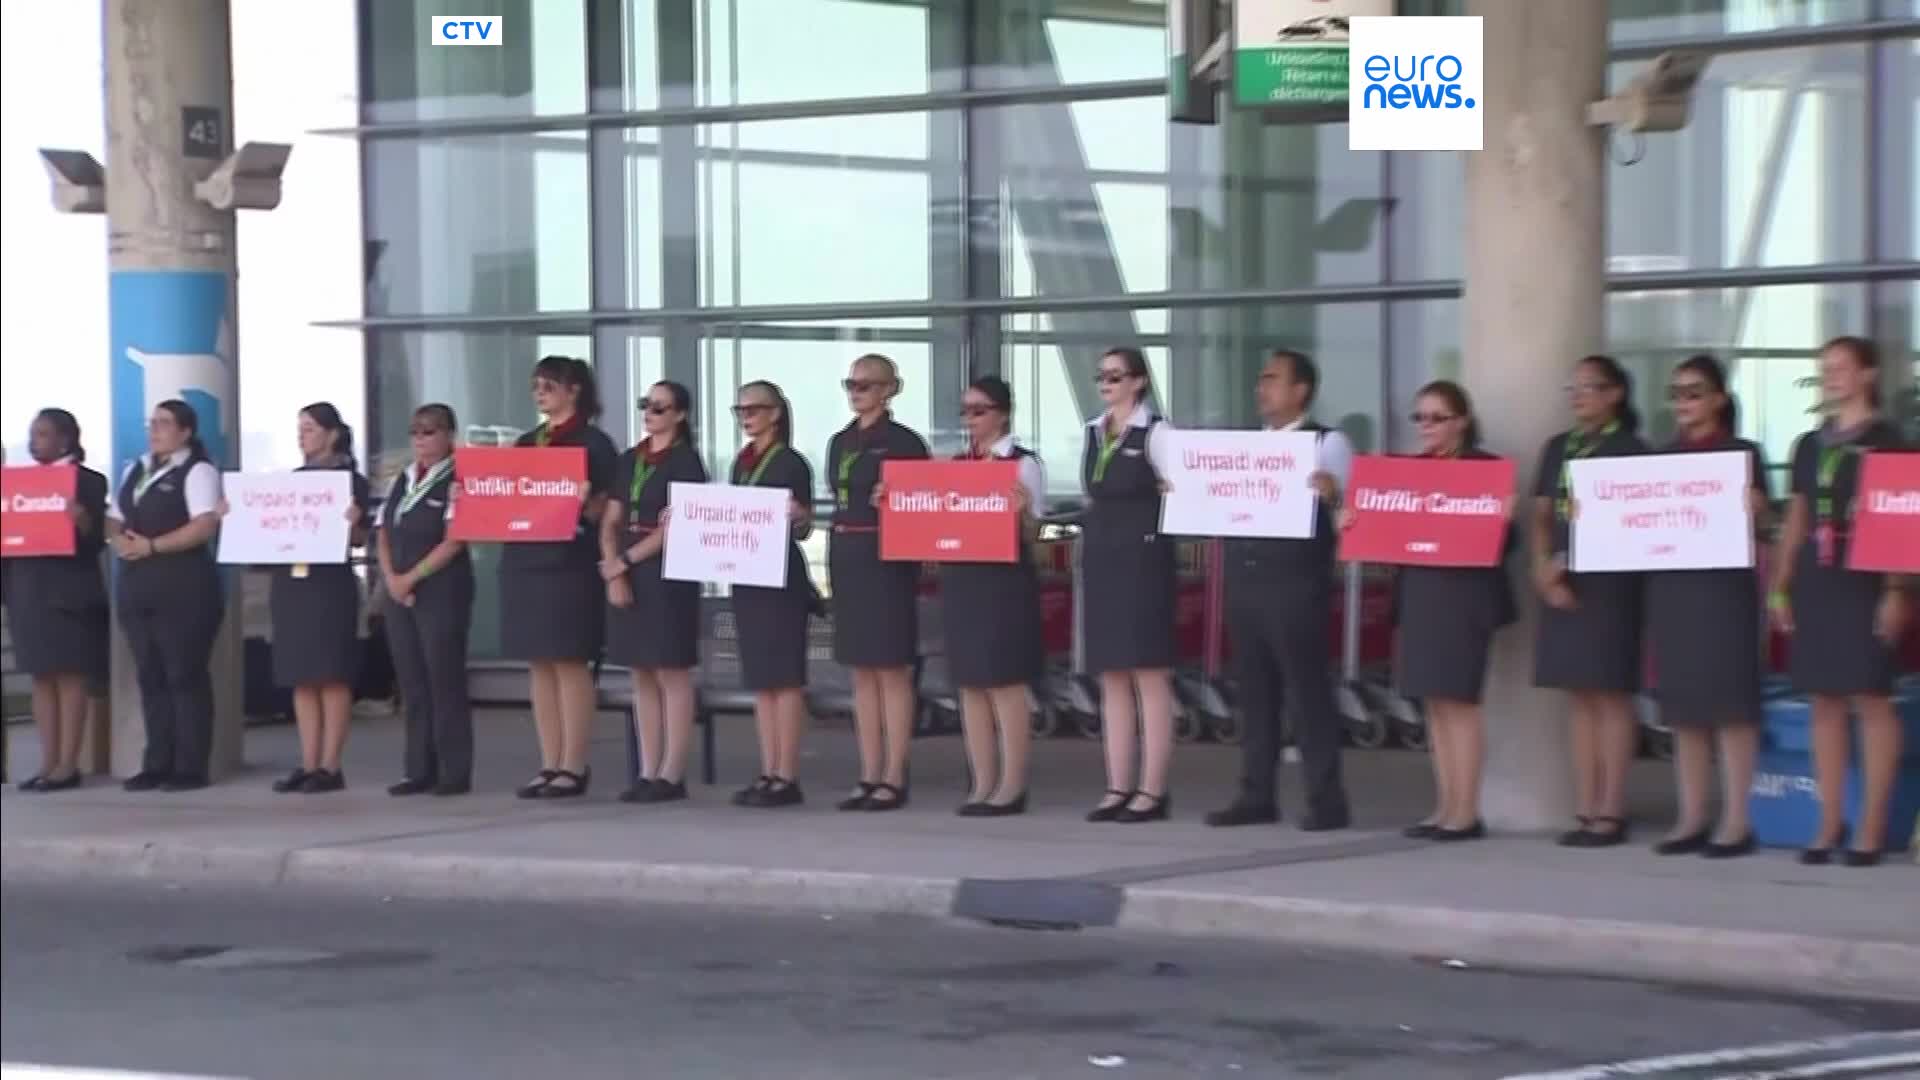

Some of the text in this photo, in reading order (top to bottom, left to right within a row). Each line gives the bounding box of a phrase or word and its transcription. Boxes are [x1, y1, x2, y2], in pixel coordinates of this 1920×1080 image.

[189, 120, 218, 144] 43
[1183, 449, 1297, 476] Unpaid work
[517, 476, 579, 497] Canada
[13, 493, 67, 512] Canada
[242, 489, 335, 510] Unpaid work
[944, 491, 1008, 512] Canada
[1424, 491, 1501, 515] Canada
[303, 511, 320, 535] fly
[684, 502, 776, 526] Unpaid work
